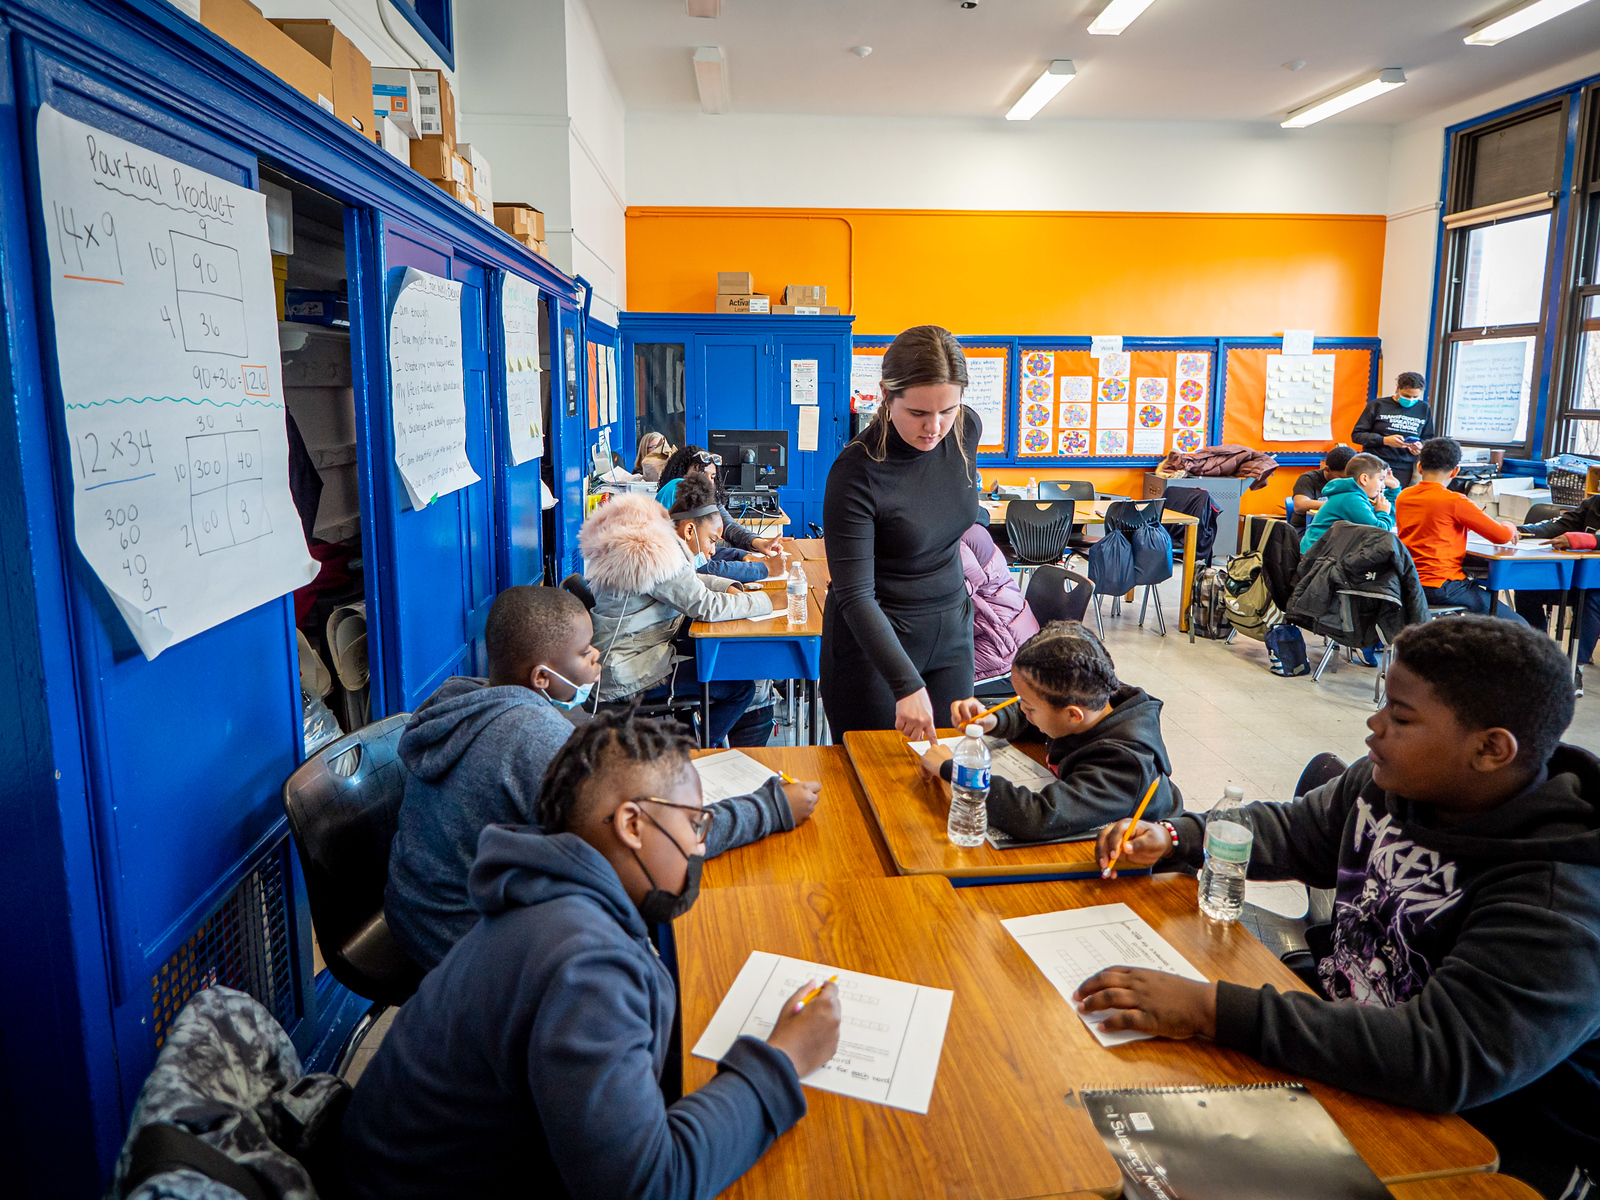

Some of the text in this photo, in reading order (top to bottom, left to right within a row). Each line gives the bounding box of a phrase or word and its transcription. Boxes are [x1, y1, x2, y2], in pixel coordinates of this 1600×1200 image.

[86, 135, 235, 218] Partial Product
[199, 219, 208, 239] 9
[149, 242, 167, 270] 10
[193, 253, 217, 284] 90
[729, 298, 750, 306] Activa
[160, 305, 176, 338] 4
[200, 313, 220, 337] 36
[196, 413, 243, 432] 30 4
[194, 460, 221, 478] 300
[237, 452, 253, 469] 40
[174, 464, 186, 482] 10
[105, 504, 138, 530] 300
[202, 510, 218, 533] 60
[240, 499, 250, 525] 8
[120, 525, 141, 550] 60
[181, 525, 192, 548] 2
[123, 555, 147, 576] 40
[143, 579, 152, 601] 8
[1110, 1120, 1147, 1173] SUBJECT
[1142, 1175, 1170, 1200] NOTE
